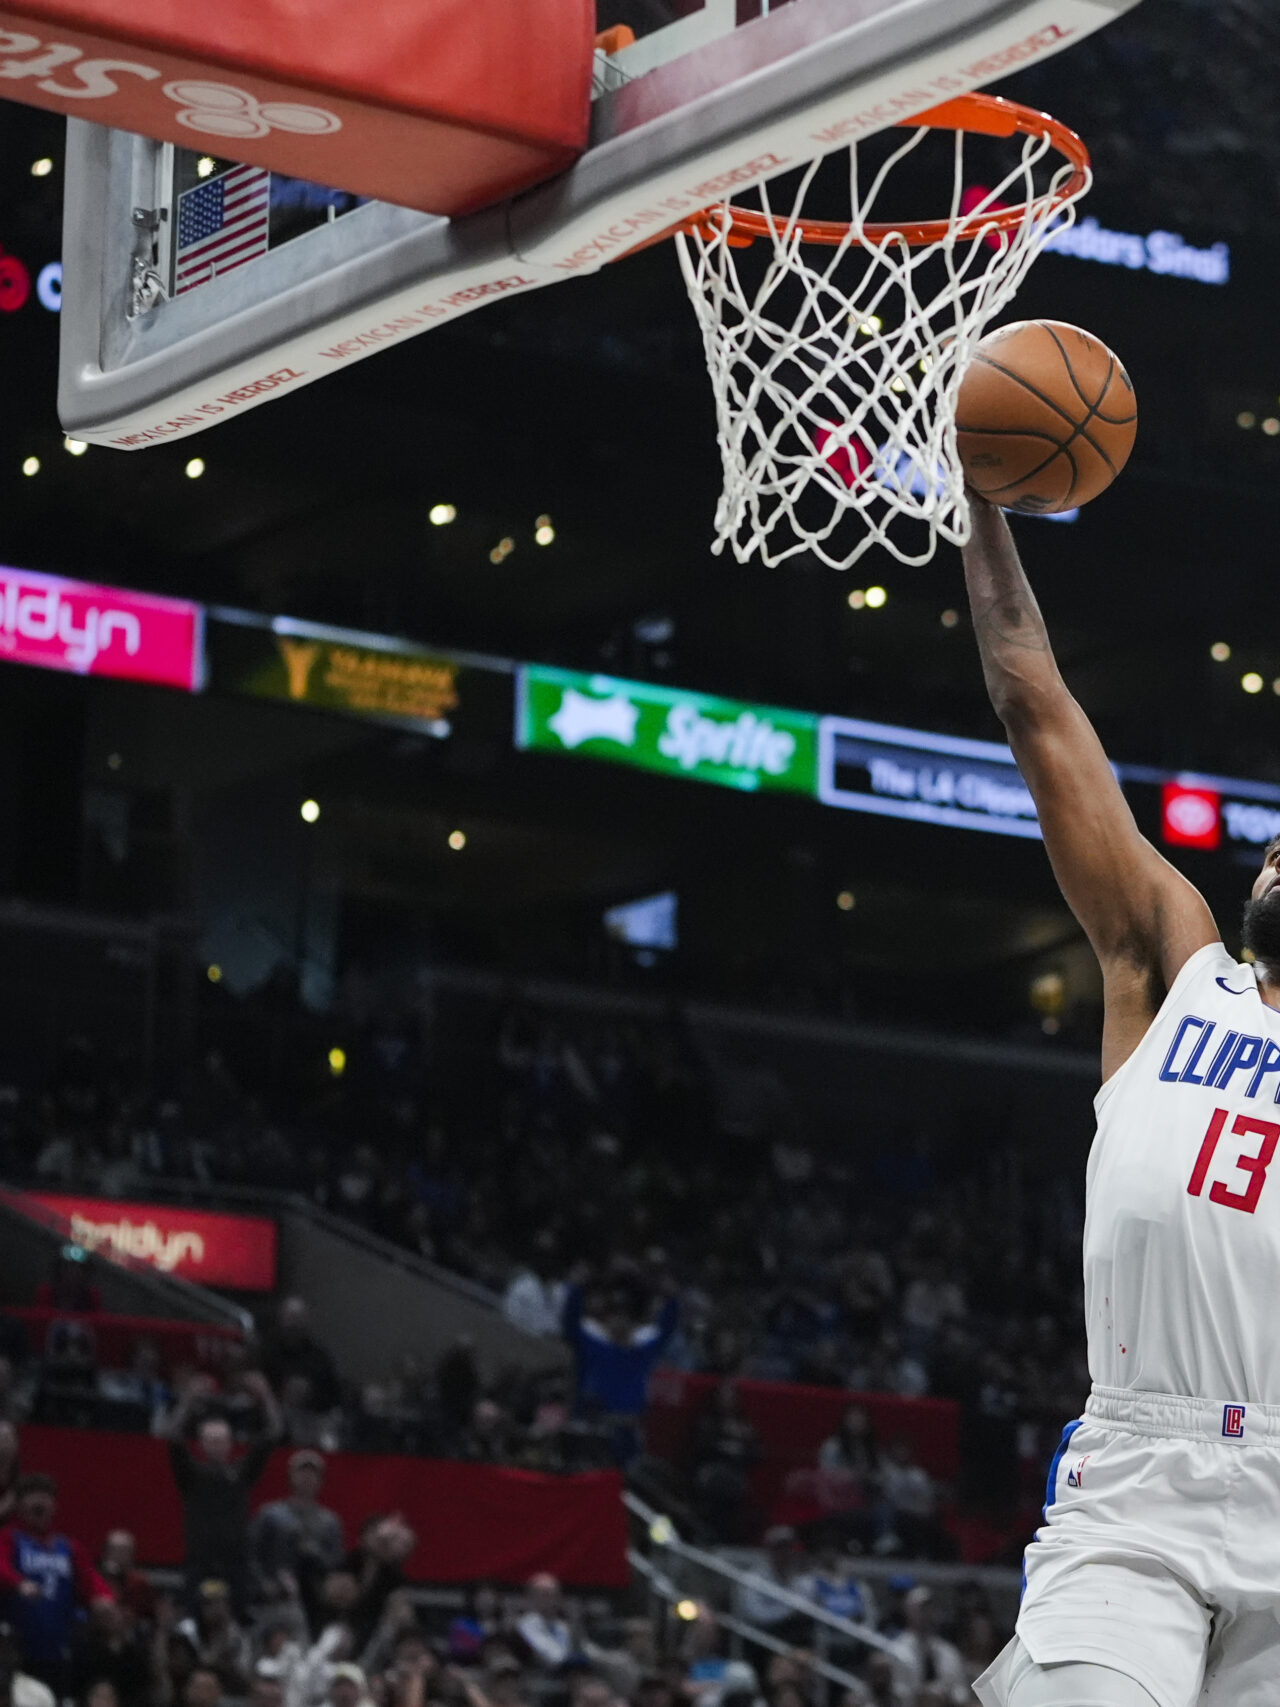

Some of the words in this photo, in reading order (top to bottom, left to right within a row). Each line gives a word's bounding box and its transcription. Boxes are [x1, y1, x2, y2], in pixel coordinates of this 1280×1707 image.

[811, 89, 934, 144] MEXICAN
[928, 76, 963, 92] IS
[958, 24, 1076, 79] HERDEZ
[552, 209, 666, 270] MEXICAN
[658, 197, 691, 212] IS
[685, 153, 791, 199] HERDEZ
[319, 316, 423, 360] MEXICAN
[416, 304, 446, 317] IS
[439, 275, 537, 307] HERDEZ
[110, 408, 204, 446] MEXICAN
[199, 404, 225, 415] IS
[216, 367, 307, 405] HERDEZ
[0, 582, 140, 672] ldyn
[658, 702, 796, 775] Sprite
[868, 757, 915, 797] The
[918, 767, 955, 803] LA
